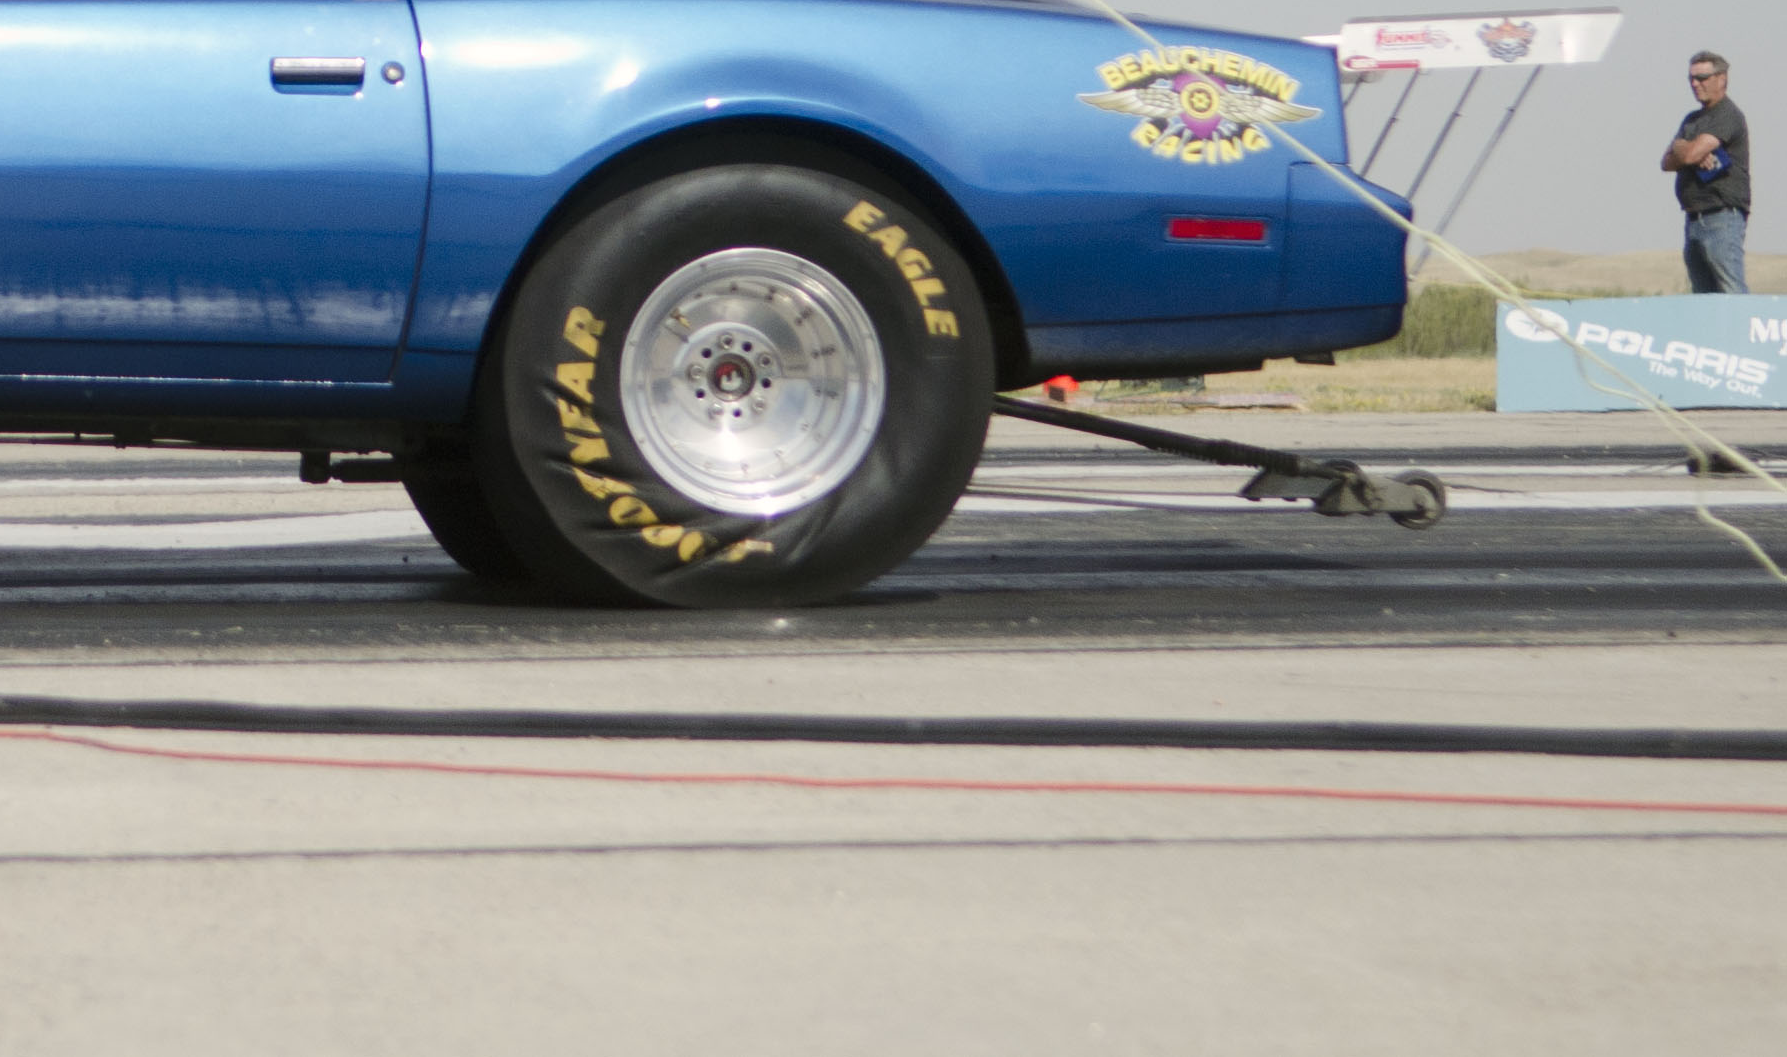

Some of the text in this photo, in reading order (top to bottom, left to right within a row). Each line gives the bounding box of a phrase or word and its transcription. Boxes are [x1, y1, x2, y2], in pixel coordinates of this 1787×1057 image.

[1096, 45, 1302, 103] BEAUCHEMIN
[1131, 120, 1272, 165] RACING
[842, 199, 960, 340] EAGLE
[1575, 321, 1771, 385] POLARIS
[1648, 360, 1679, 378] The
[1683, 367, 1723, 389] Way
